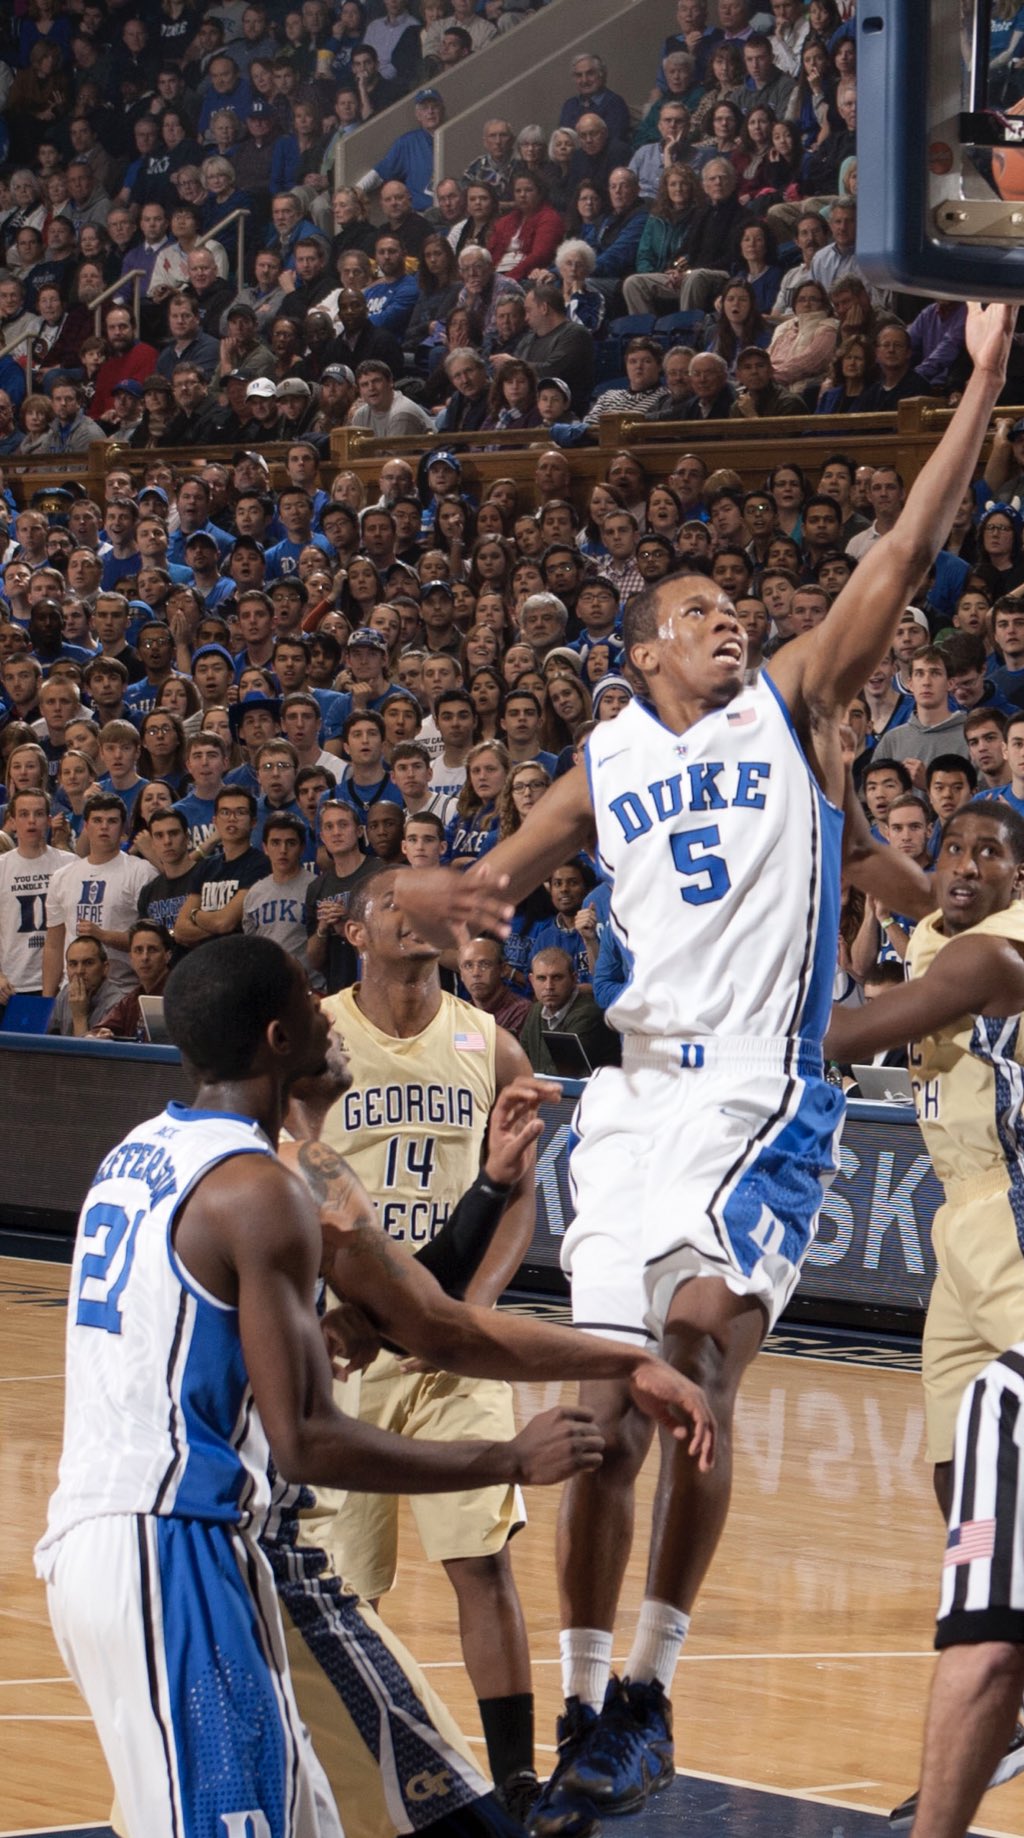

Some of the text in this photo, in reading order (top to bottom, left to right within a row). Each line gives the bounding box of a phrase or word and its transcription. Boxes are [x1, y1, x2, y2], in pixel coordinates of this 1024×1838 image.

[608, 761, 771, 844] DUKE
[11, 883, 43, 892] HANDLE
[669, 824, 731, 906] 5
[680, 1043, 705, 1068] D
[343, 1083, 474, 1131] GEORGIA
[382, 1136, 435, 1191] 14
[749, 1203, 786, 1256] D
[75, 1202, 146, 1335] 21
